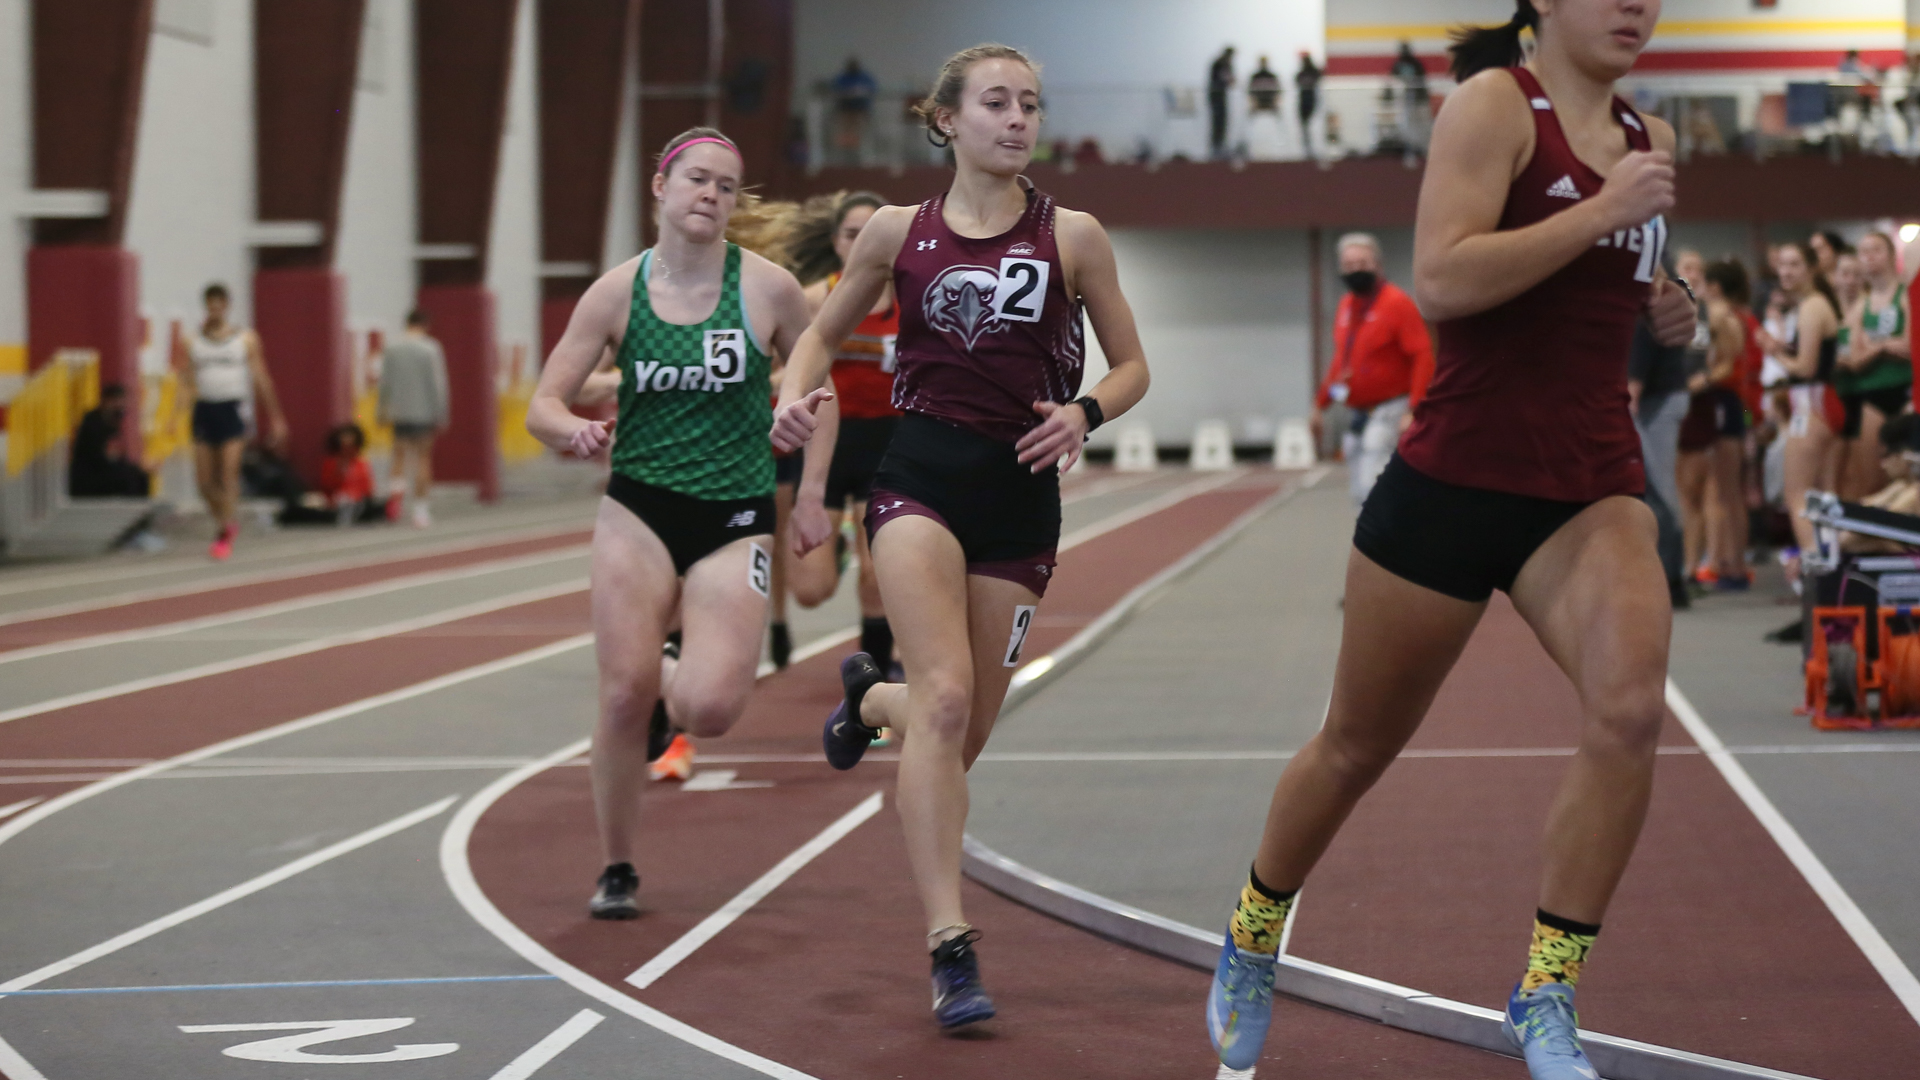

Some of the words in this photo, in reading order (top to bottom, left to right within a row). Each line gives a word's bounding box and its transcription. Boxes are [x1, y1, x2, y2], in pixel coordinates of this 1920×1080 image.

[1546, 187, 1581, 200] adidas
[1000, 262, 1040, 318] 2
[711, 333, 739, 379] 5
[753, 549, 768, 594] 5
[1008, 609, 1031, 663] 2
[177, 1017, 460, 1064] 2
